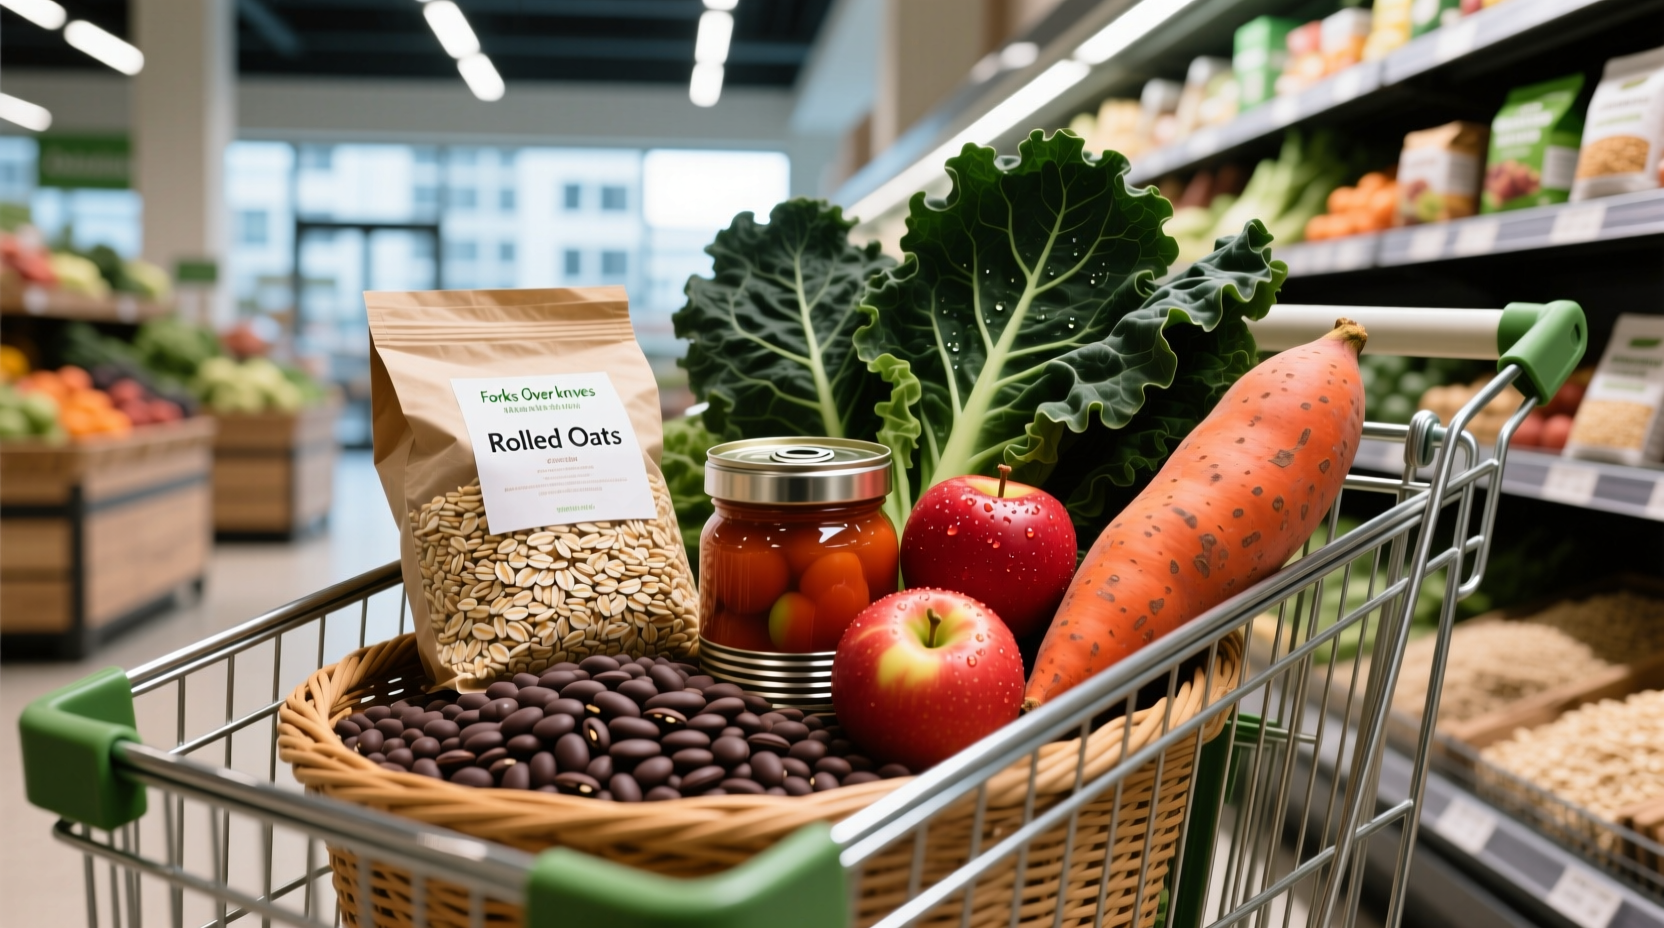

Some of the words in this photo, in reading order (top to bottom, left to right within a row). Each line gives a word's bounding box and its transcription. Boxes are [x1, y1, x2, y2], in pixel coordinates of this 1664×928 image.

[480, 388, 519, 403] Forks
[487, 427, 563, 453] Rolled
[567, 425, 622, 448] Oats
